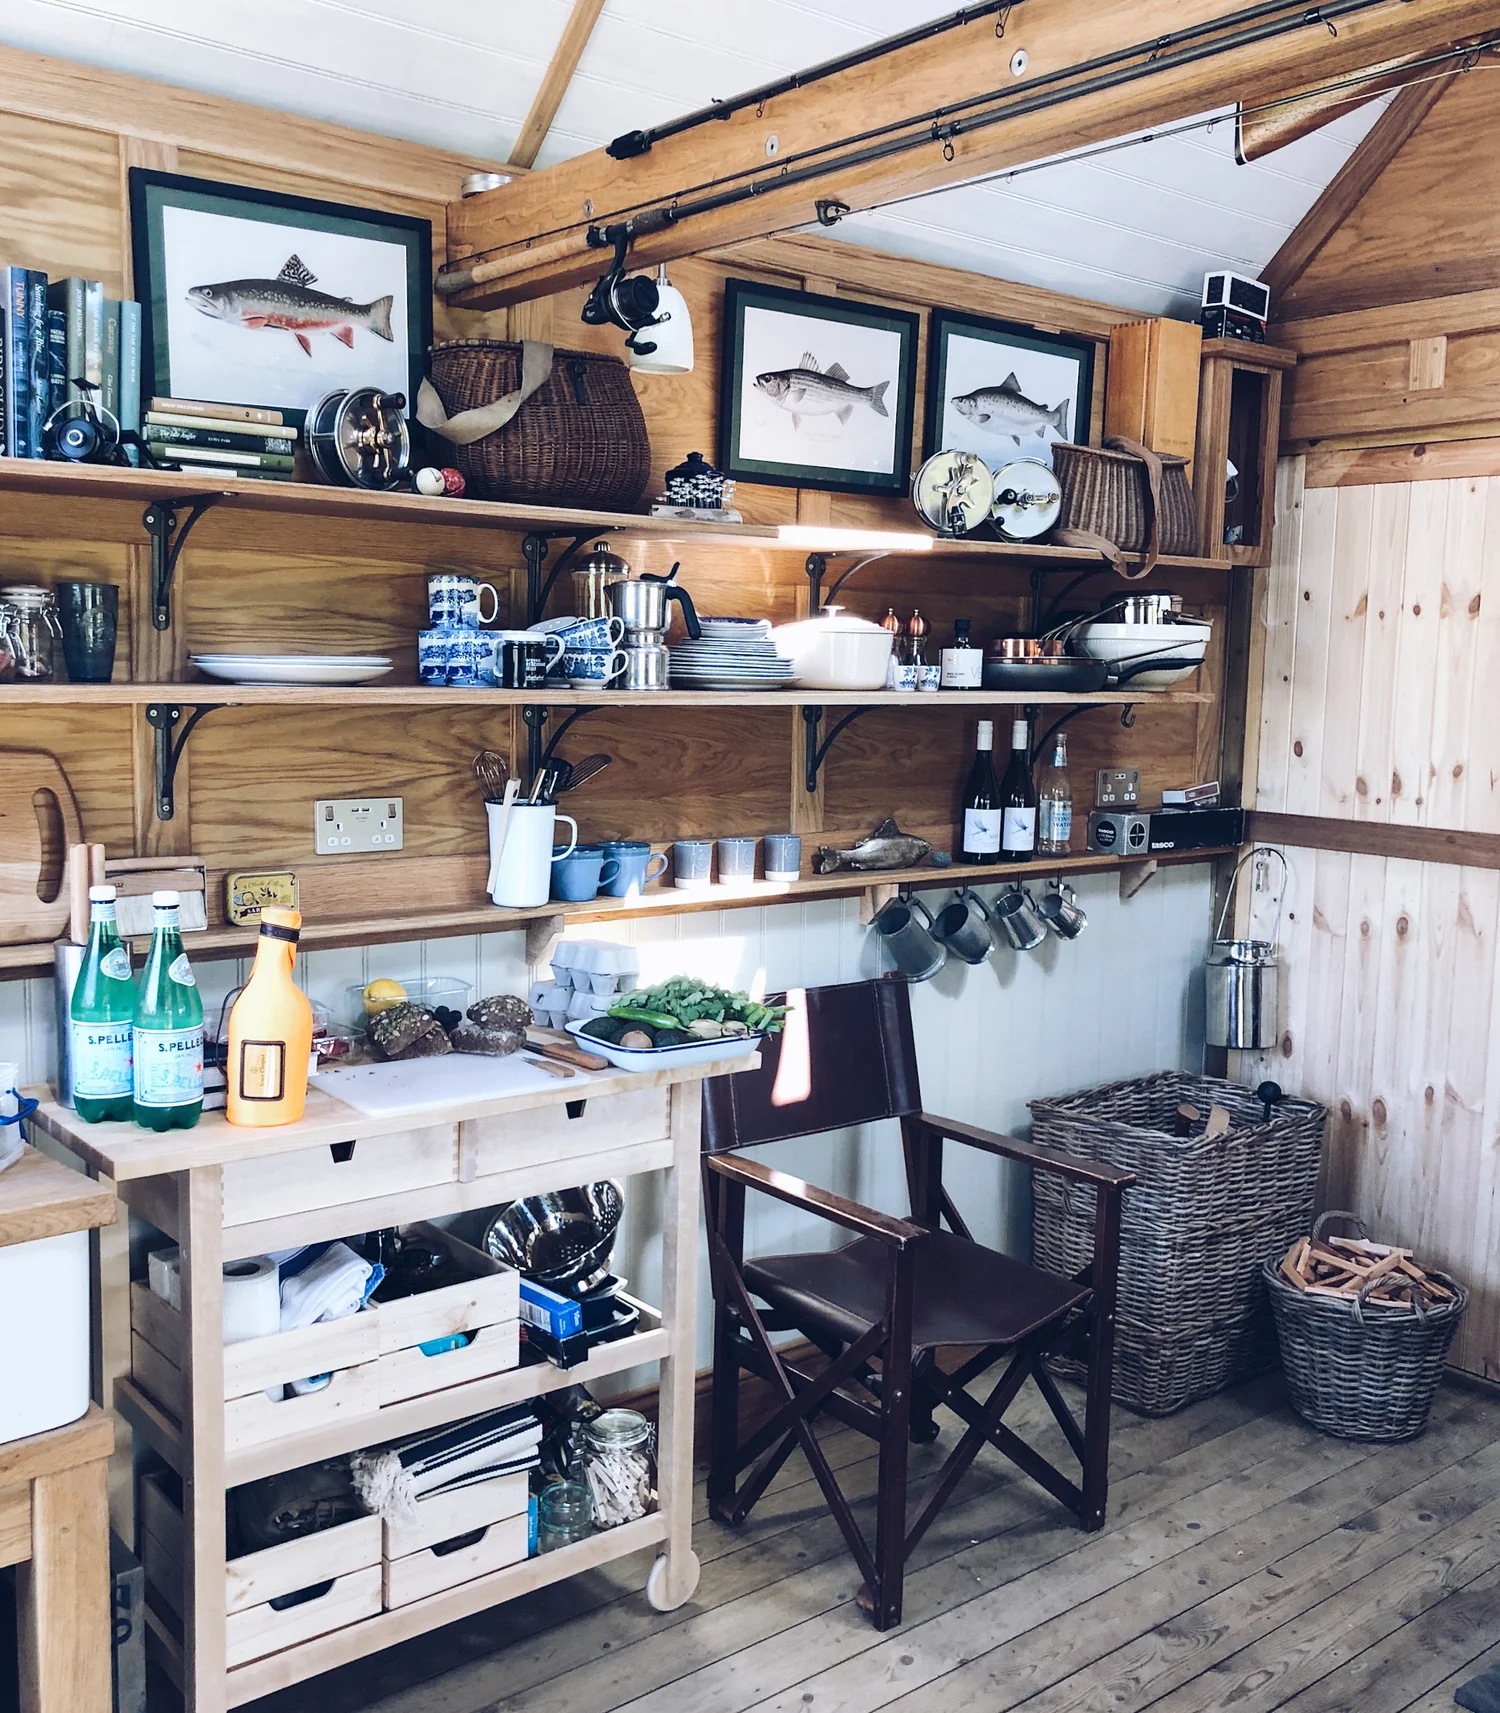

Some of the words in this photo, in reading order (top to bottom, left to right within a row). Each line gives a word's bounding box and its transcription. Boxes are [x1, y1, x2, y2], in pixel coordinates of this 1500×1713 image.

[16, 282, 25, 318] TUNNY
[34, 283, 45, 320] Searching
[34, 319, 45, 329] for
[34, 336, 45, 353] Rise
[107, 318, 117, 355] Castaway
[180, 432, 197, 441] Angler
[1151, 841, 1175, 849] tasco
